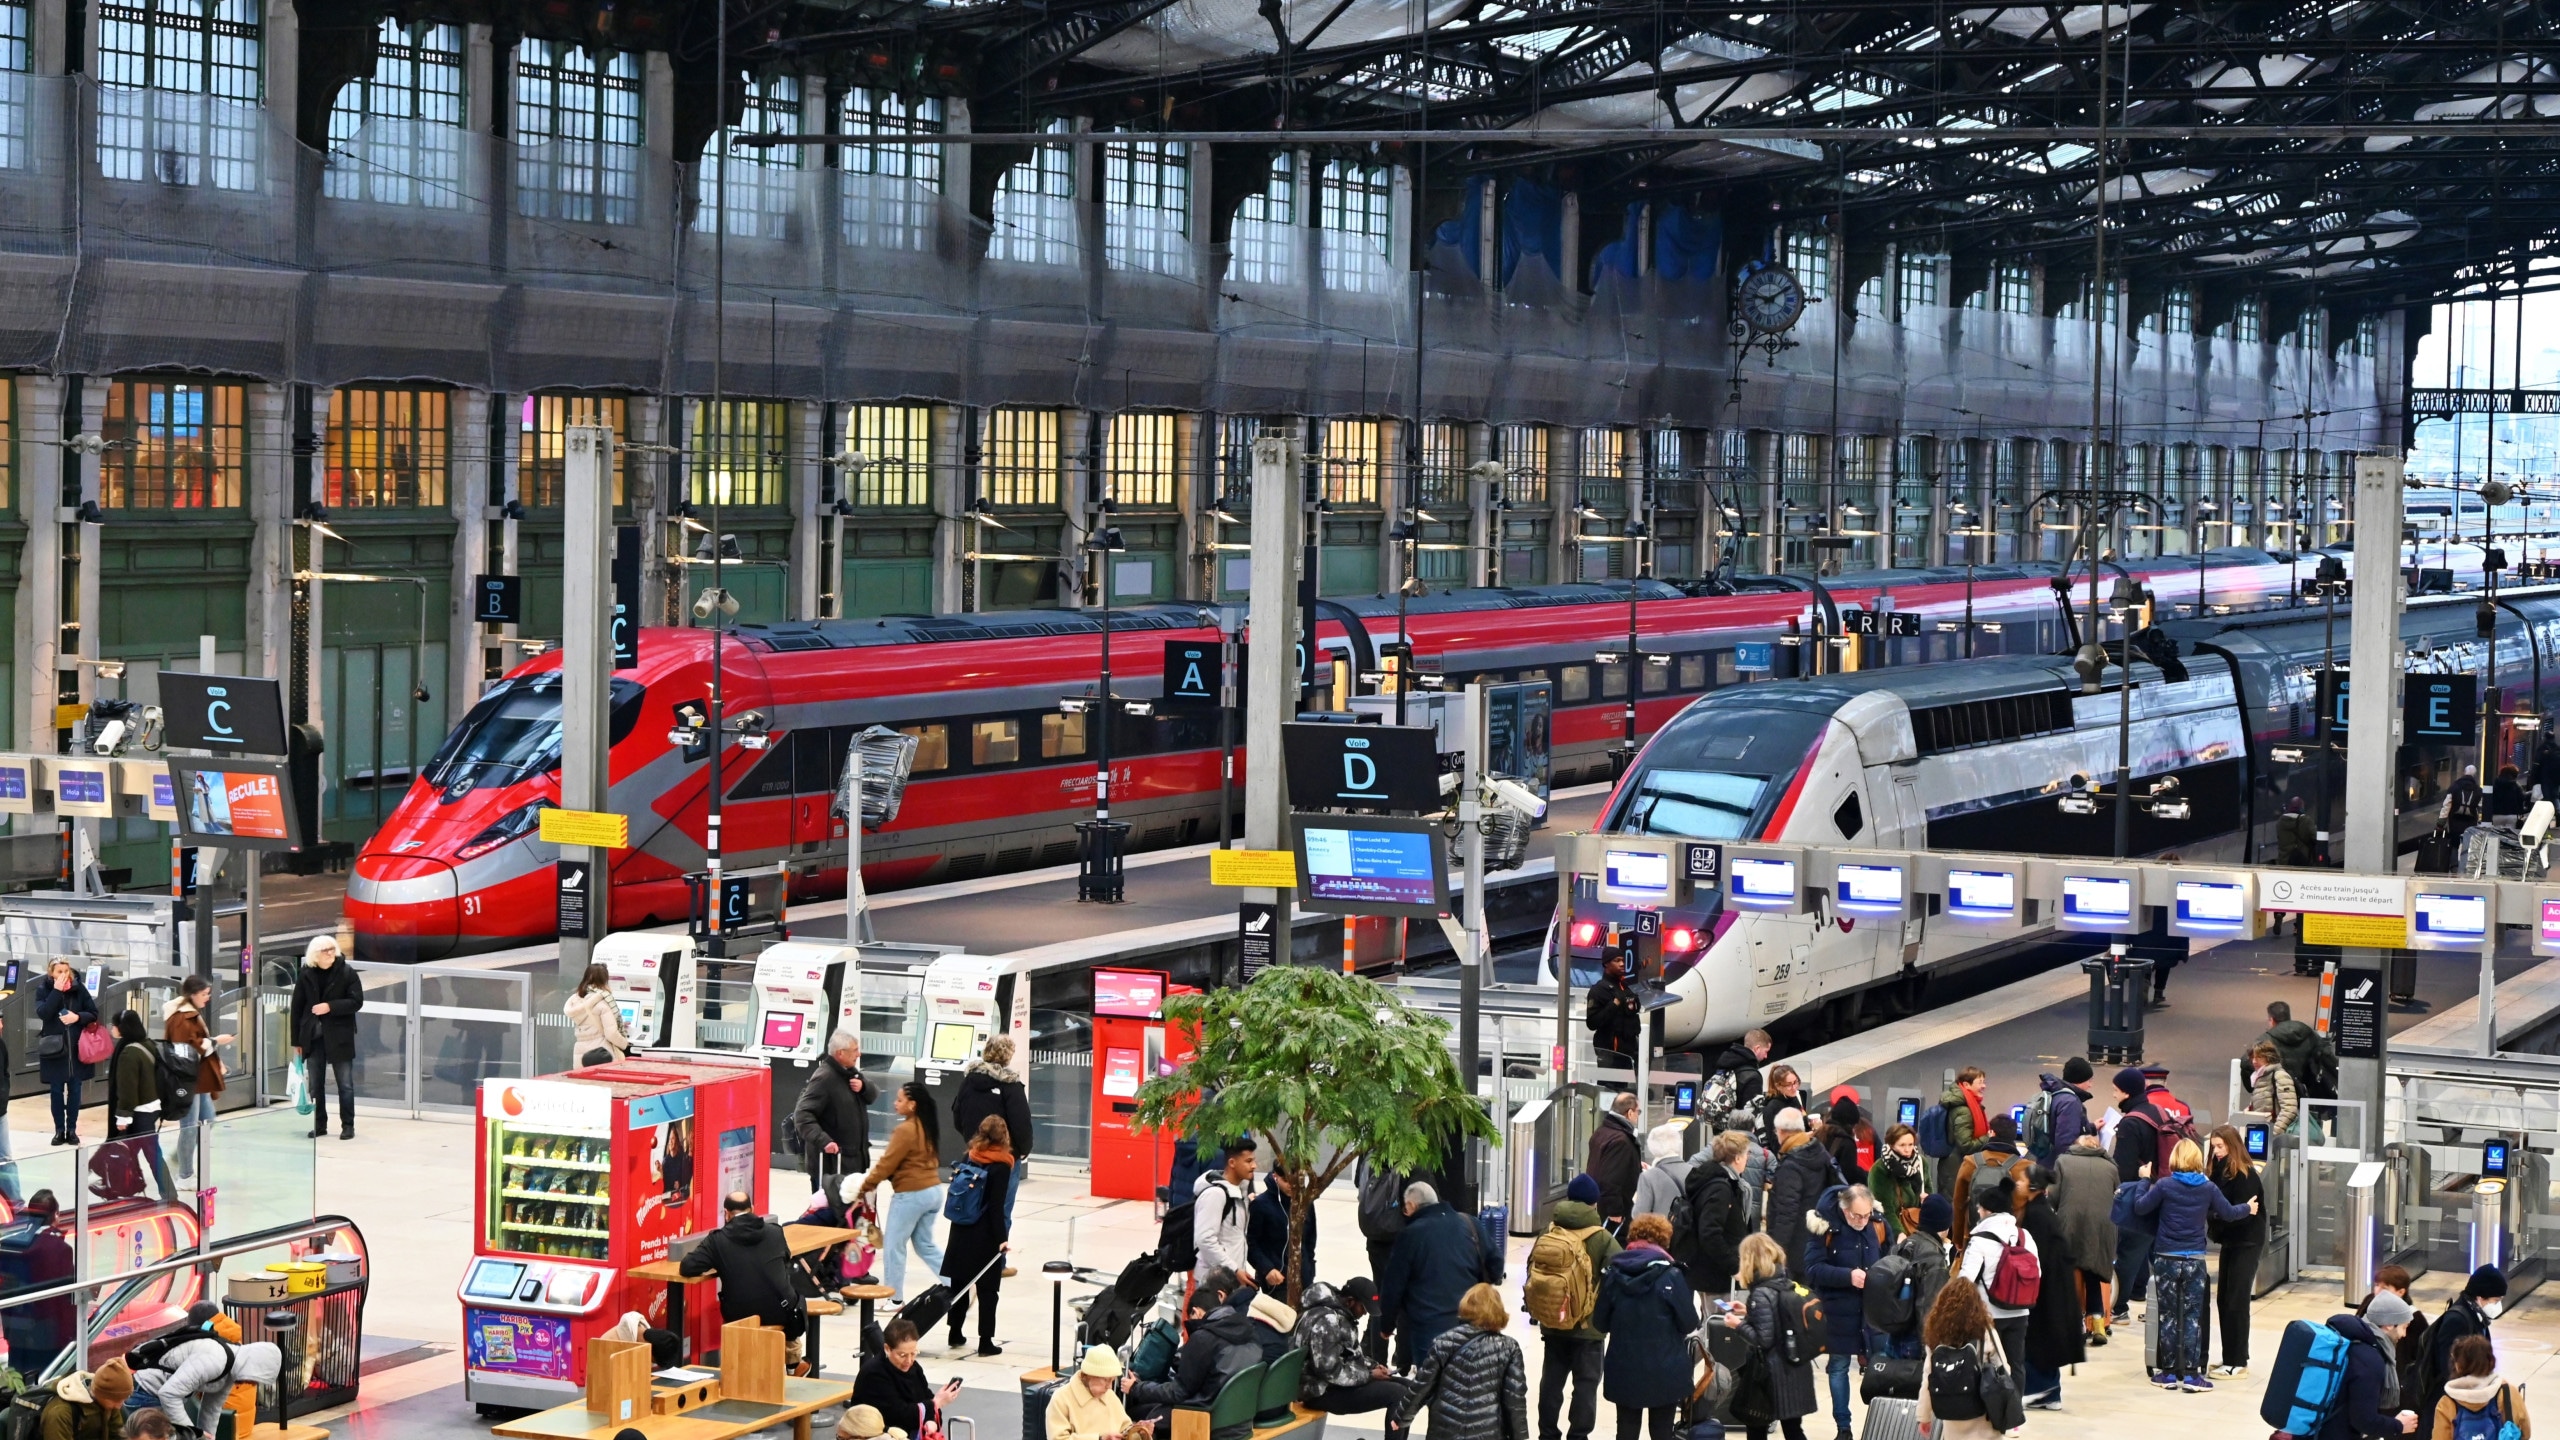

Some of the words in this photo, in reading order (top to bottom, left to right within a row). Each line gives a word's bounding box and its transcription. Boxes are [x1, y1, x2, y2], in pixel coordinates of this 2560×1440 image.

[489, 593, 501, 614] B
[1862, 616, 1872, 633] R
[1892, 618, 1902, 634] R
[612, 618, 627, 650] C
[1182, 662, 1204, 690] A
[210, 688, 224, 696] Voie
[208, 700, 233, 734] C
[2429, 697, 2450, 727] E
[1348, 740, 1366, 748] Voie
[1343, 753, 1376, 790] D
[228, 778, 269, 804] RECULE
[270, 776, 277, 796] !
[2352, 886, 2379, 895] jusqu'à
[464, 896, 481, 916] 31
[728, 894, 740, 916] C
[1625, 949, 1633, 973] D
[1774, 963, 1790, 980] 259
[641, 1236, 661, 1251] Prends
[663, 1235, 668, 1245] la
[641, 1252, 653, 1263] avec
[500, 1314, 528, 1325] HARIBO
[520, 1326, 530, 1334] PIK
